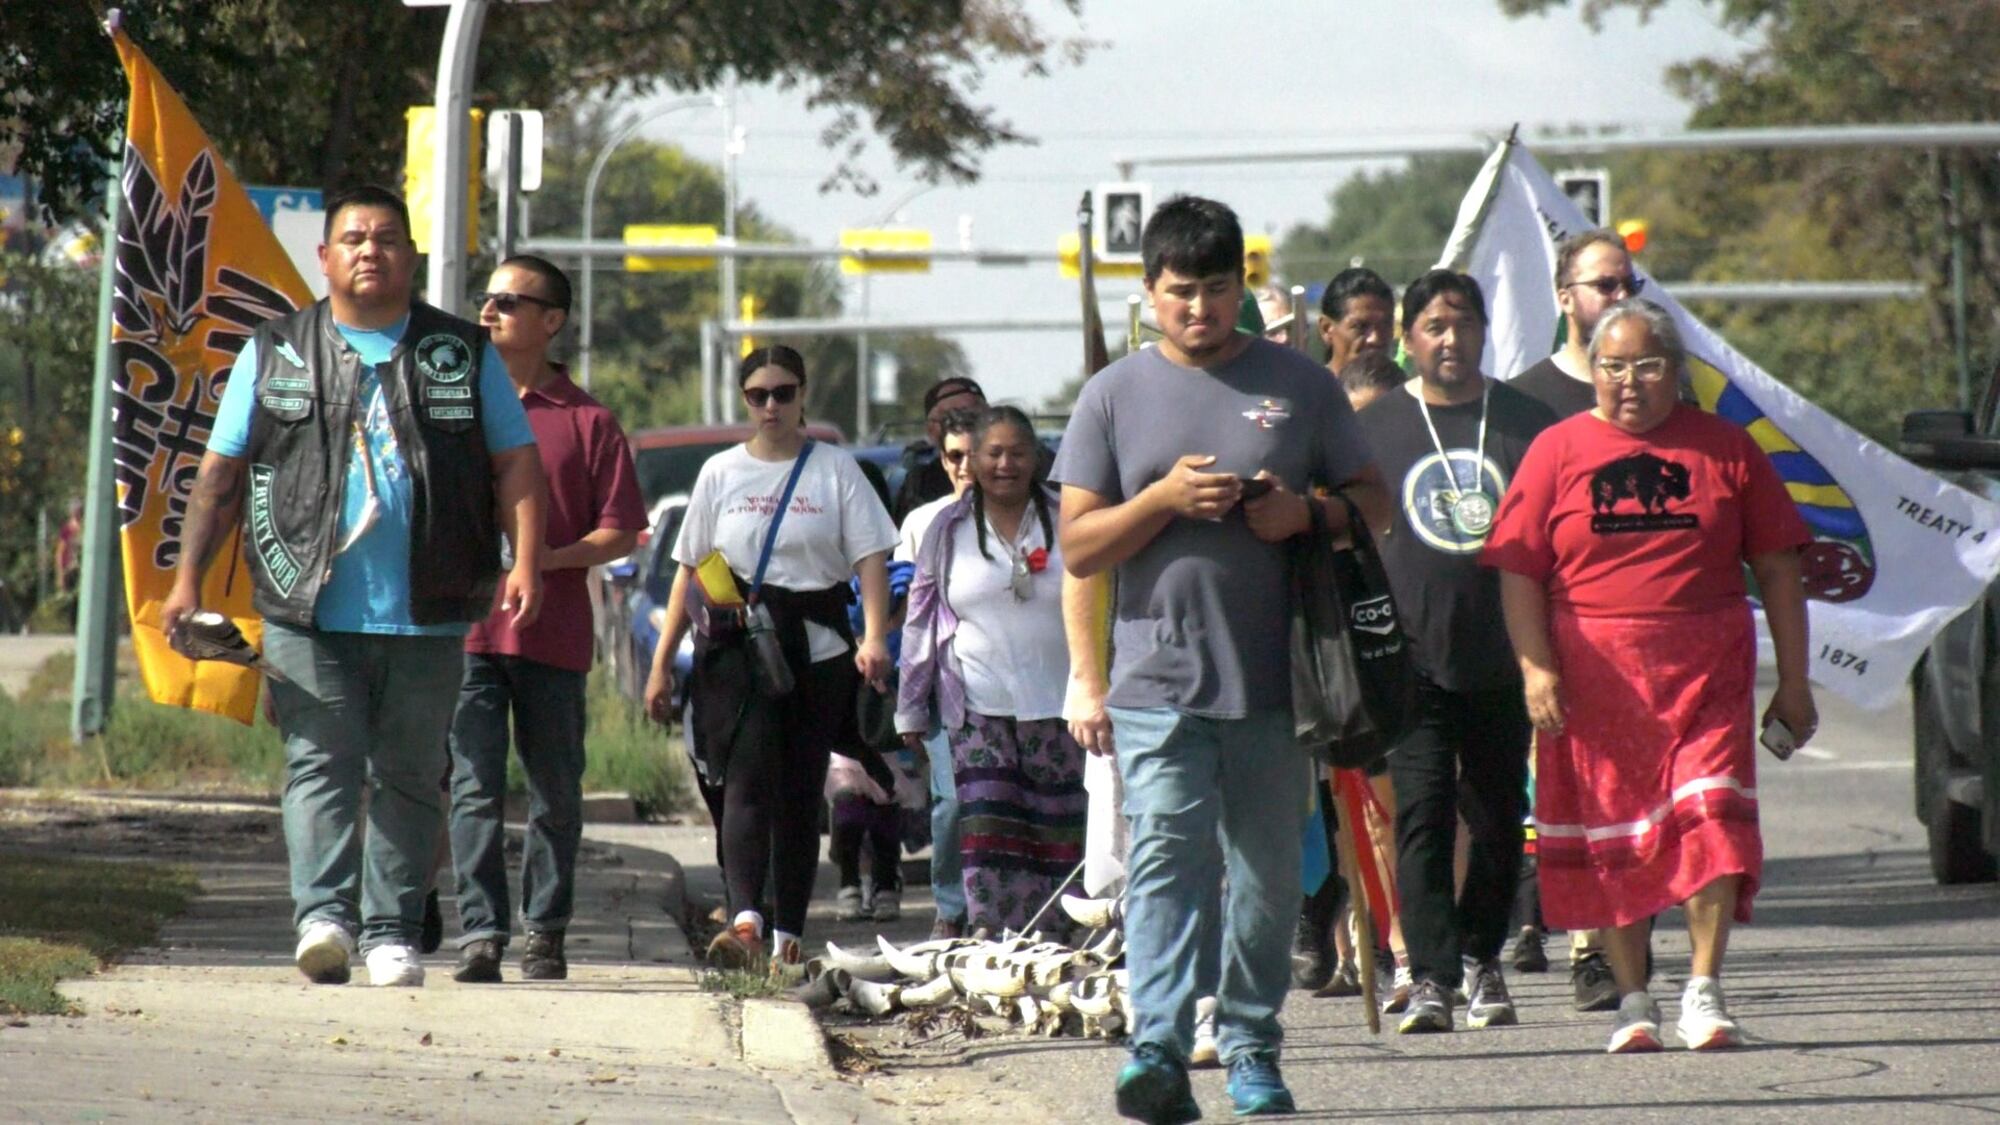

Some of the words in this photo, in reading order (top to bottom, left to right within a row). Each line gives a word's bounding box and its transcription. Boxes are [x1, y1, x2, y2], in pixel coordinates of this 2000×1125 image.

[255, 471, 275, 546] TREATY
[266, 541, 297, 589] FOUR
[1897, 496, 1972, 539] TREATY
[1971, 530, 1988, 545] 4
[1355, 603, 1392, 623] CO-O
[1819, 643, 1869, 677] 1874
